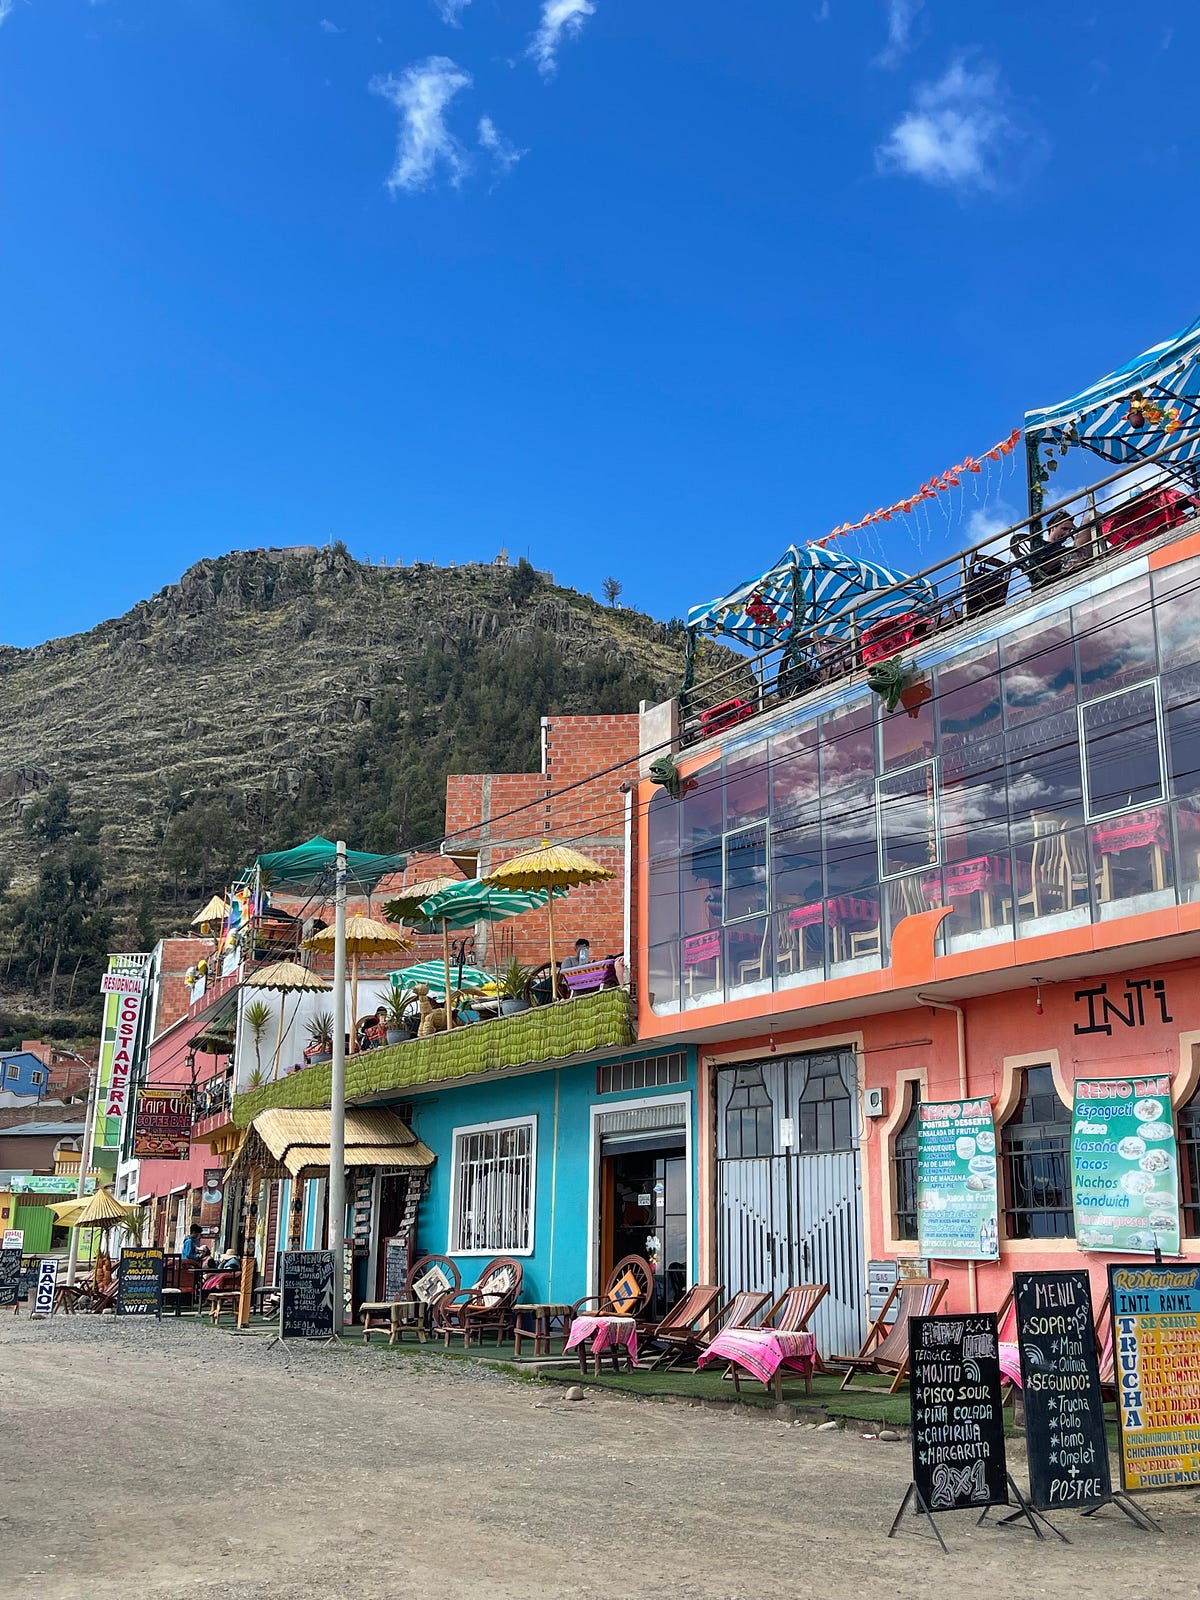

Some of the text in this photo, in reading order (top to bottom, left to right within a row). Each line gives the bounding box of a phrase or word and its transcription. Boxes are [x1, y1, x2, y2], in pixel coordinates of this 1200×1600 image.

[104, 976, 142, 993] RESIDENCIAL
[106, 997, 139, 1116] COSTANERA
[1077, 1077, 1170, 1099] RESTO BAR
[919, 1101, 992, 1121] RESTO BAR
[1076, 1102, 1133, 1120] Espagueti
[136, 1115, 192, 1127] COFFE BAR
[923, 1118, 990, 1129] POSTRES DESSERTS
[957, 1127, 979, 1135] FRUTAS
[918, 1144, 955, 1153] PANQUEQUES
[1075, 1139, 1118, 1152] Lasaña
[1075, 1156, 1109, 1170] Tacos
[1075, 1175, 1118, 1188] Nachos
[37, 1265, 55, 1304] BAÑO
[1114, 1269, 1199, 1290] Restaurant
[1035, 1282, 1075, 1309] MENU
[1120, 1295, 1191, 1312] INTI RAYMI
[1140, 1316, 1198, 1329] SE SIRVE
[1142, 1332, 1156, 1343] AL
[1141, 1344, 1200, 1356] AL AJILL
[1142, 1358, 1148, 1370] A
[1151, 1358, 1162, 1370] LA
[922, 1364, 961, 1383] MOJITO
[1118, 1317, 1143, 1428] TRUCHA
[1143, 1373, 1149, 1385] A
[1151, 1371, 1162, 1385] LA
[923, 1386, 990, 1404] PISCO SOUR
[1144, 1387, 1150, 1399] A
[1150, 1386, 1160, 1399] LA
[1058, 1392, 1089, 1412] Trucha
[1146, 1401, 1152, 1414] A
[1154, 1400, 1168, 1413] LA
[924, 1405, 992, 1424] PIÑA COLADA
[1060, 1413, 1080, 1430] Pollo
[1148, 1415, 1154, 1428] A
[1156, 1414, 1168, 1428] LA
[924, 1420, 980, 1444] CAIPIRIÑA
[1173, 1431, 1181, 1441] DE
[928, 1442, 989, 1464] MARGARITA
[1060, 1441, 1095, 1467] Omelet
[1126, 1445, 1178, 1459] CHICHARRON
[1180, 1444, 1190, 1455] DE
[1127, 1459, 1184, 1473] PEJERREY
[1139, 1472, 1172, 1486] PIQUE
[1049, 1478, 1101, 1502] POSTRE
